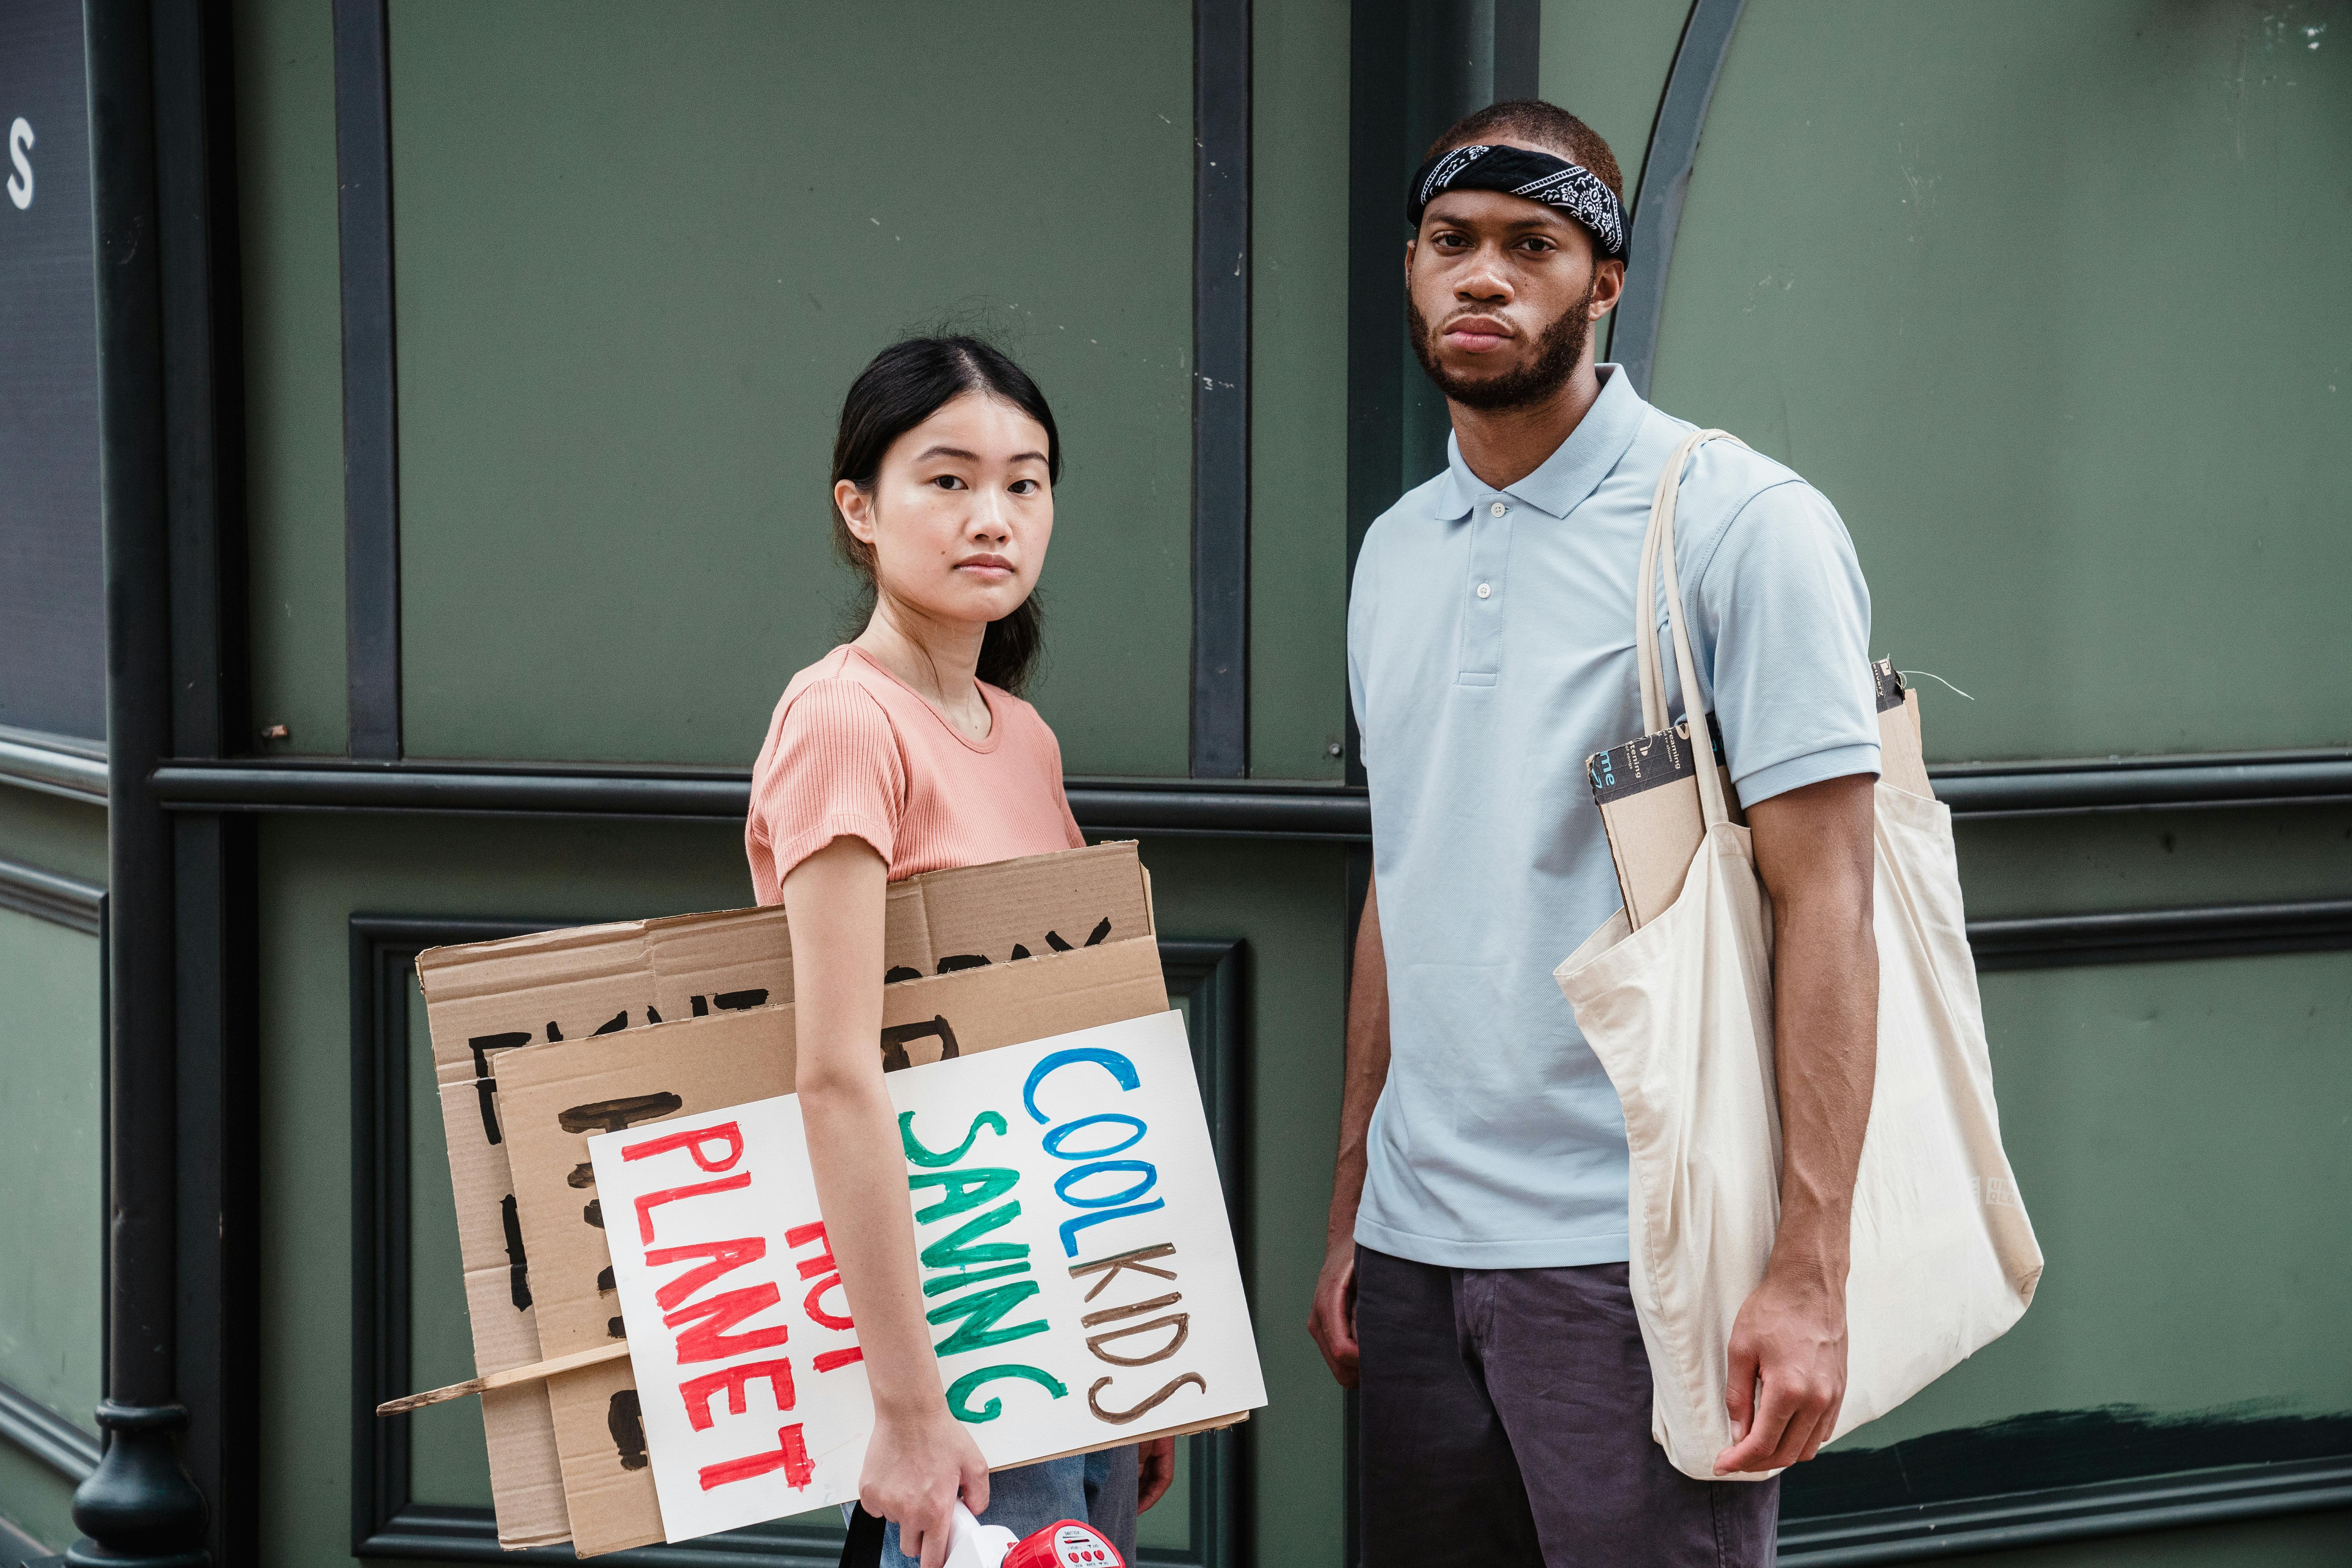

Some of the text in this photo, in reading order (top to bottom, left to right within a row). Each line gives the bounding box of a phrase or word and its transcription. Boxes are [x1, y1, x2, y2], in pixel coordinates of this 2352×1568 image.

[7, 117, 34, 210] S
[1873, 664, 1884, 696] elivery
[1600, 750, 1615, 786] me
[1628, 740, 1642, 779] stening
[1668, 729, 1681, 769] treaming
[898, 1111, 1069, 1424] SAVING
[1023, 1047, 1207, 1425] COOL KIDS
[621, 1121, 815, 1492] PLANET
